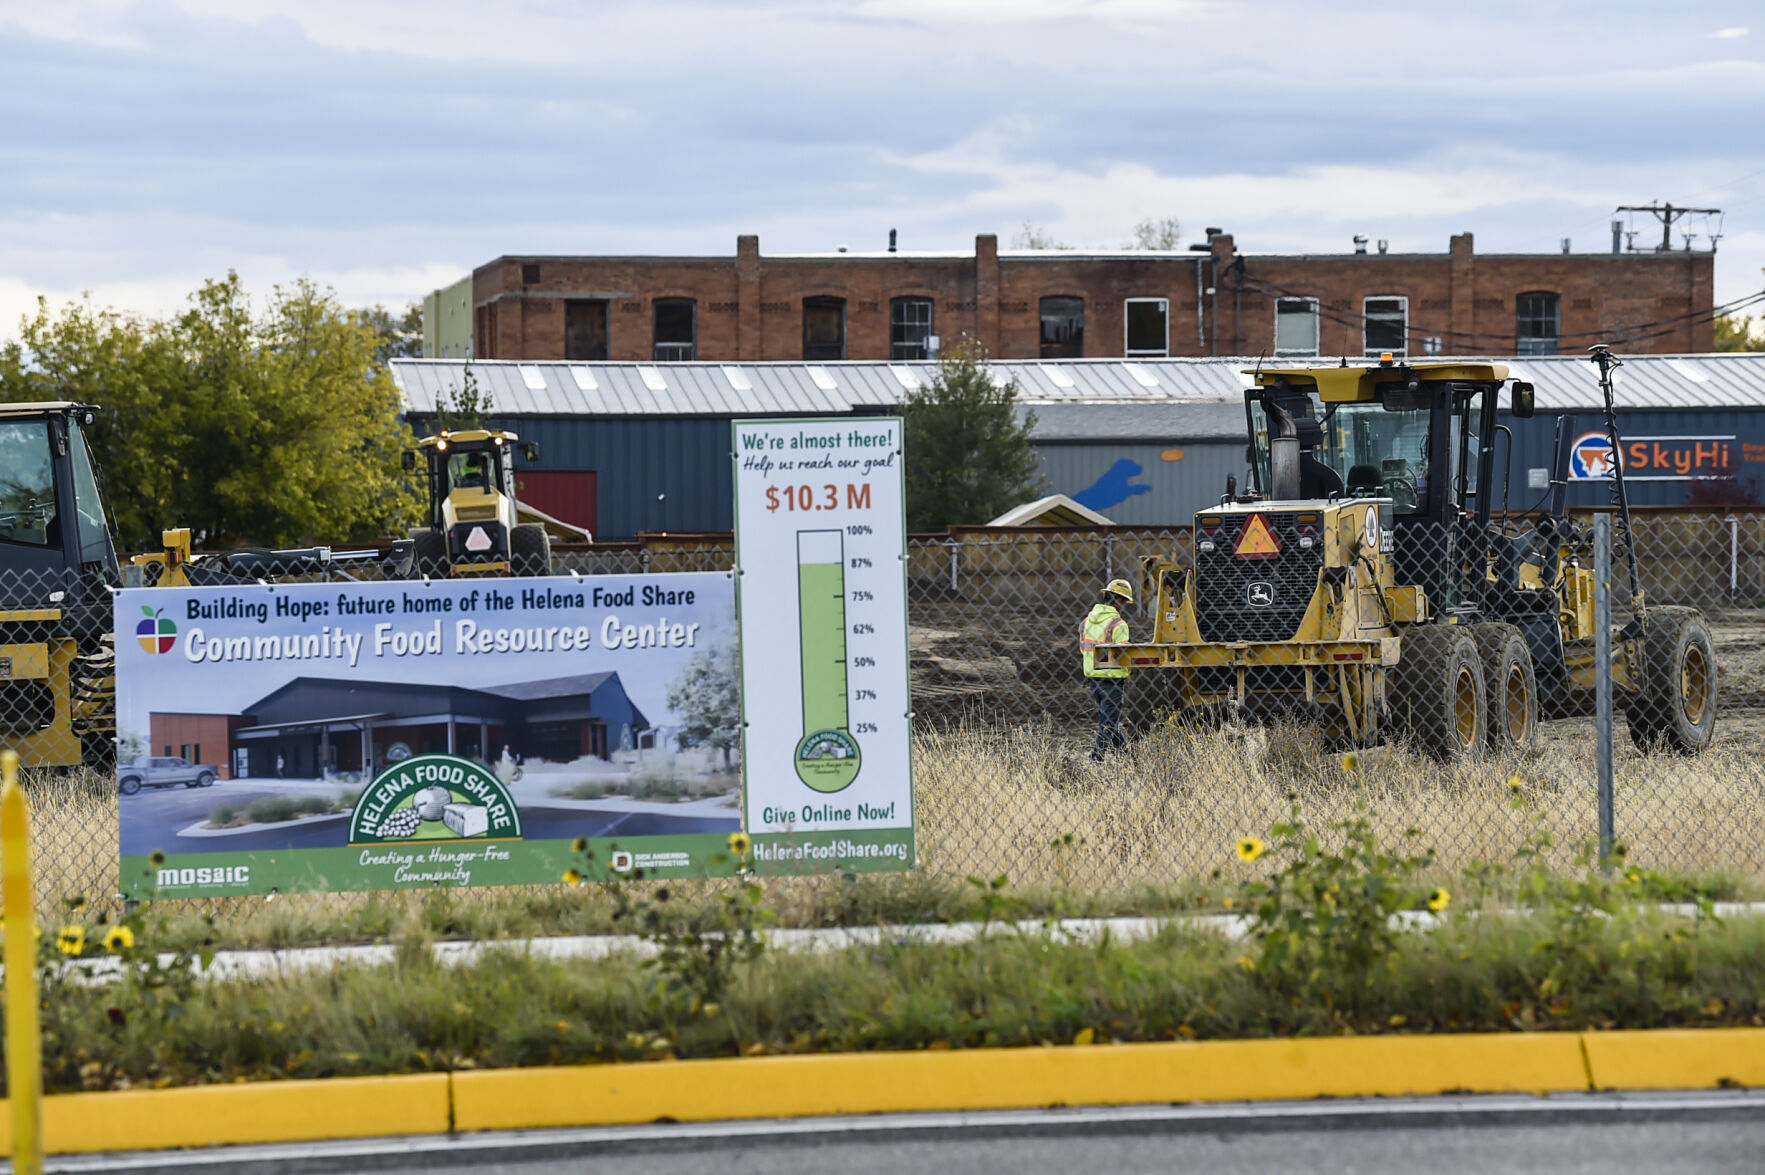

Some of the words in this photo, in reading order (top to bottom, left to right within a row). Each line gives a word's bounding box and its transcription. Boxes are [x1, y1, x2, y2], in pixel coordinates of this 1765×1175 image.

[742, 432, 785, 450] We're
[790, 431, 842, 449] almost
[847, 429, 893, 447] there!
[743, 455, 774, 478] Help
[778, 461, 794, 470] us
[797, 453, 833, 470] reach
[837, 459, 860, 468] our
[861, 451, 895, 476] goal
[1629, 441, 1729, 474] SkyHi
[765, 484, 838, 514] $10.3
[847, 483, 872, 510] M
[846, 525, 873, 536] 100%
[851, 558, 873, 569] 87%
[186, 597, 268, 623] Building
[275, 594, 329, 622] Hope:
[336, 593, 396, 616] future
[402, 592, 452, 614] home
[459, 590, 480, 612] of
[484, 588, 515, 611] the
[521, 588, 585, 609] Helena
[592, 586, 635, 607] Food
[641, 585, 696, 606] Share
[852, 591, 874, 601] 75%
[853, 624, 875, 634] 62%
[184, 626, 364, 668] Community
[374, 619, 443, 657] Food
[455, 618, 591, 655] Resource
[600, 615, 700, 651] Center
[854, 657, 876, 667] 50%
[855, 690, 877, 700] 37%
[856, 723, 878, 734] 25%
[359, 773, 415, 835] HELENA
[415, 764, 465, 784] FOOD
[463, 774, 511, 830] SHARE
[763, 806, 796, 824] Give
[802, 804, 852, 822] Online
[858, 802, 895, 820] Now!
[359, 849, 413, 869] Creating
[430, 845, 510, 868] Hunger-Free
[157, 866, 249, 885] mosaic
[394, 866, 471, 886] Community
